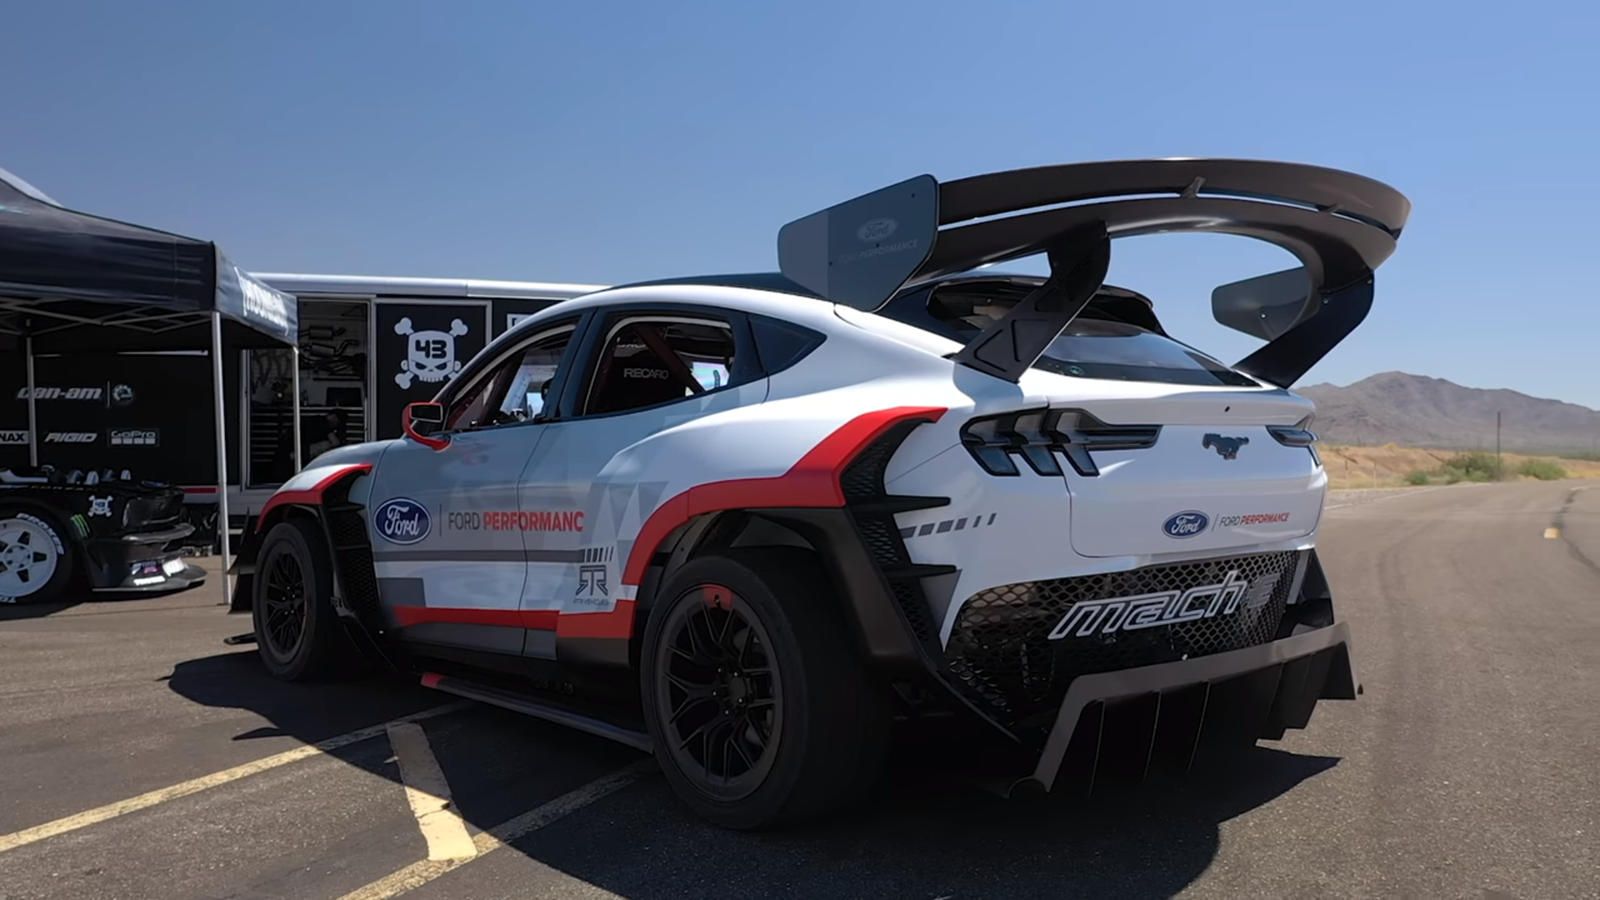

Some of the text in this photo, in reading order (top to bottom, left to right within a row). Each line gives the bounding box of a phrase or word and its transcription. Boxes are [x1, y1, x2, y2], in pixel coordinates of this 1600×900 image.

[415, 339, 447, 358] 43
[624, 367, 669, 380] RECARO
[17, 387, 102, 400] can-am
[44, 432, 97, 443] RIGID
[384, 504, 420, 536] Ford
[448, 511, 585, 532] FORD PERFORMANC
[1170, 514, 1201, 534] Ford
[1219, 511, 1290, 528] FORD PERFORMANCE
